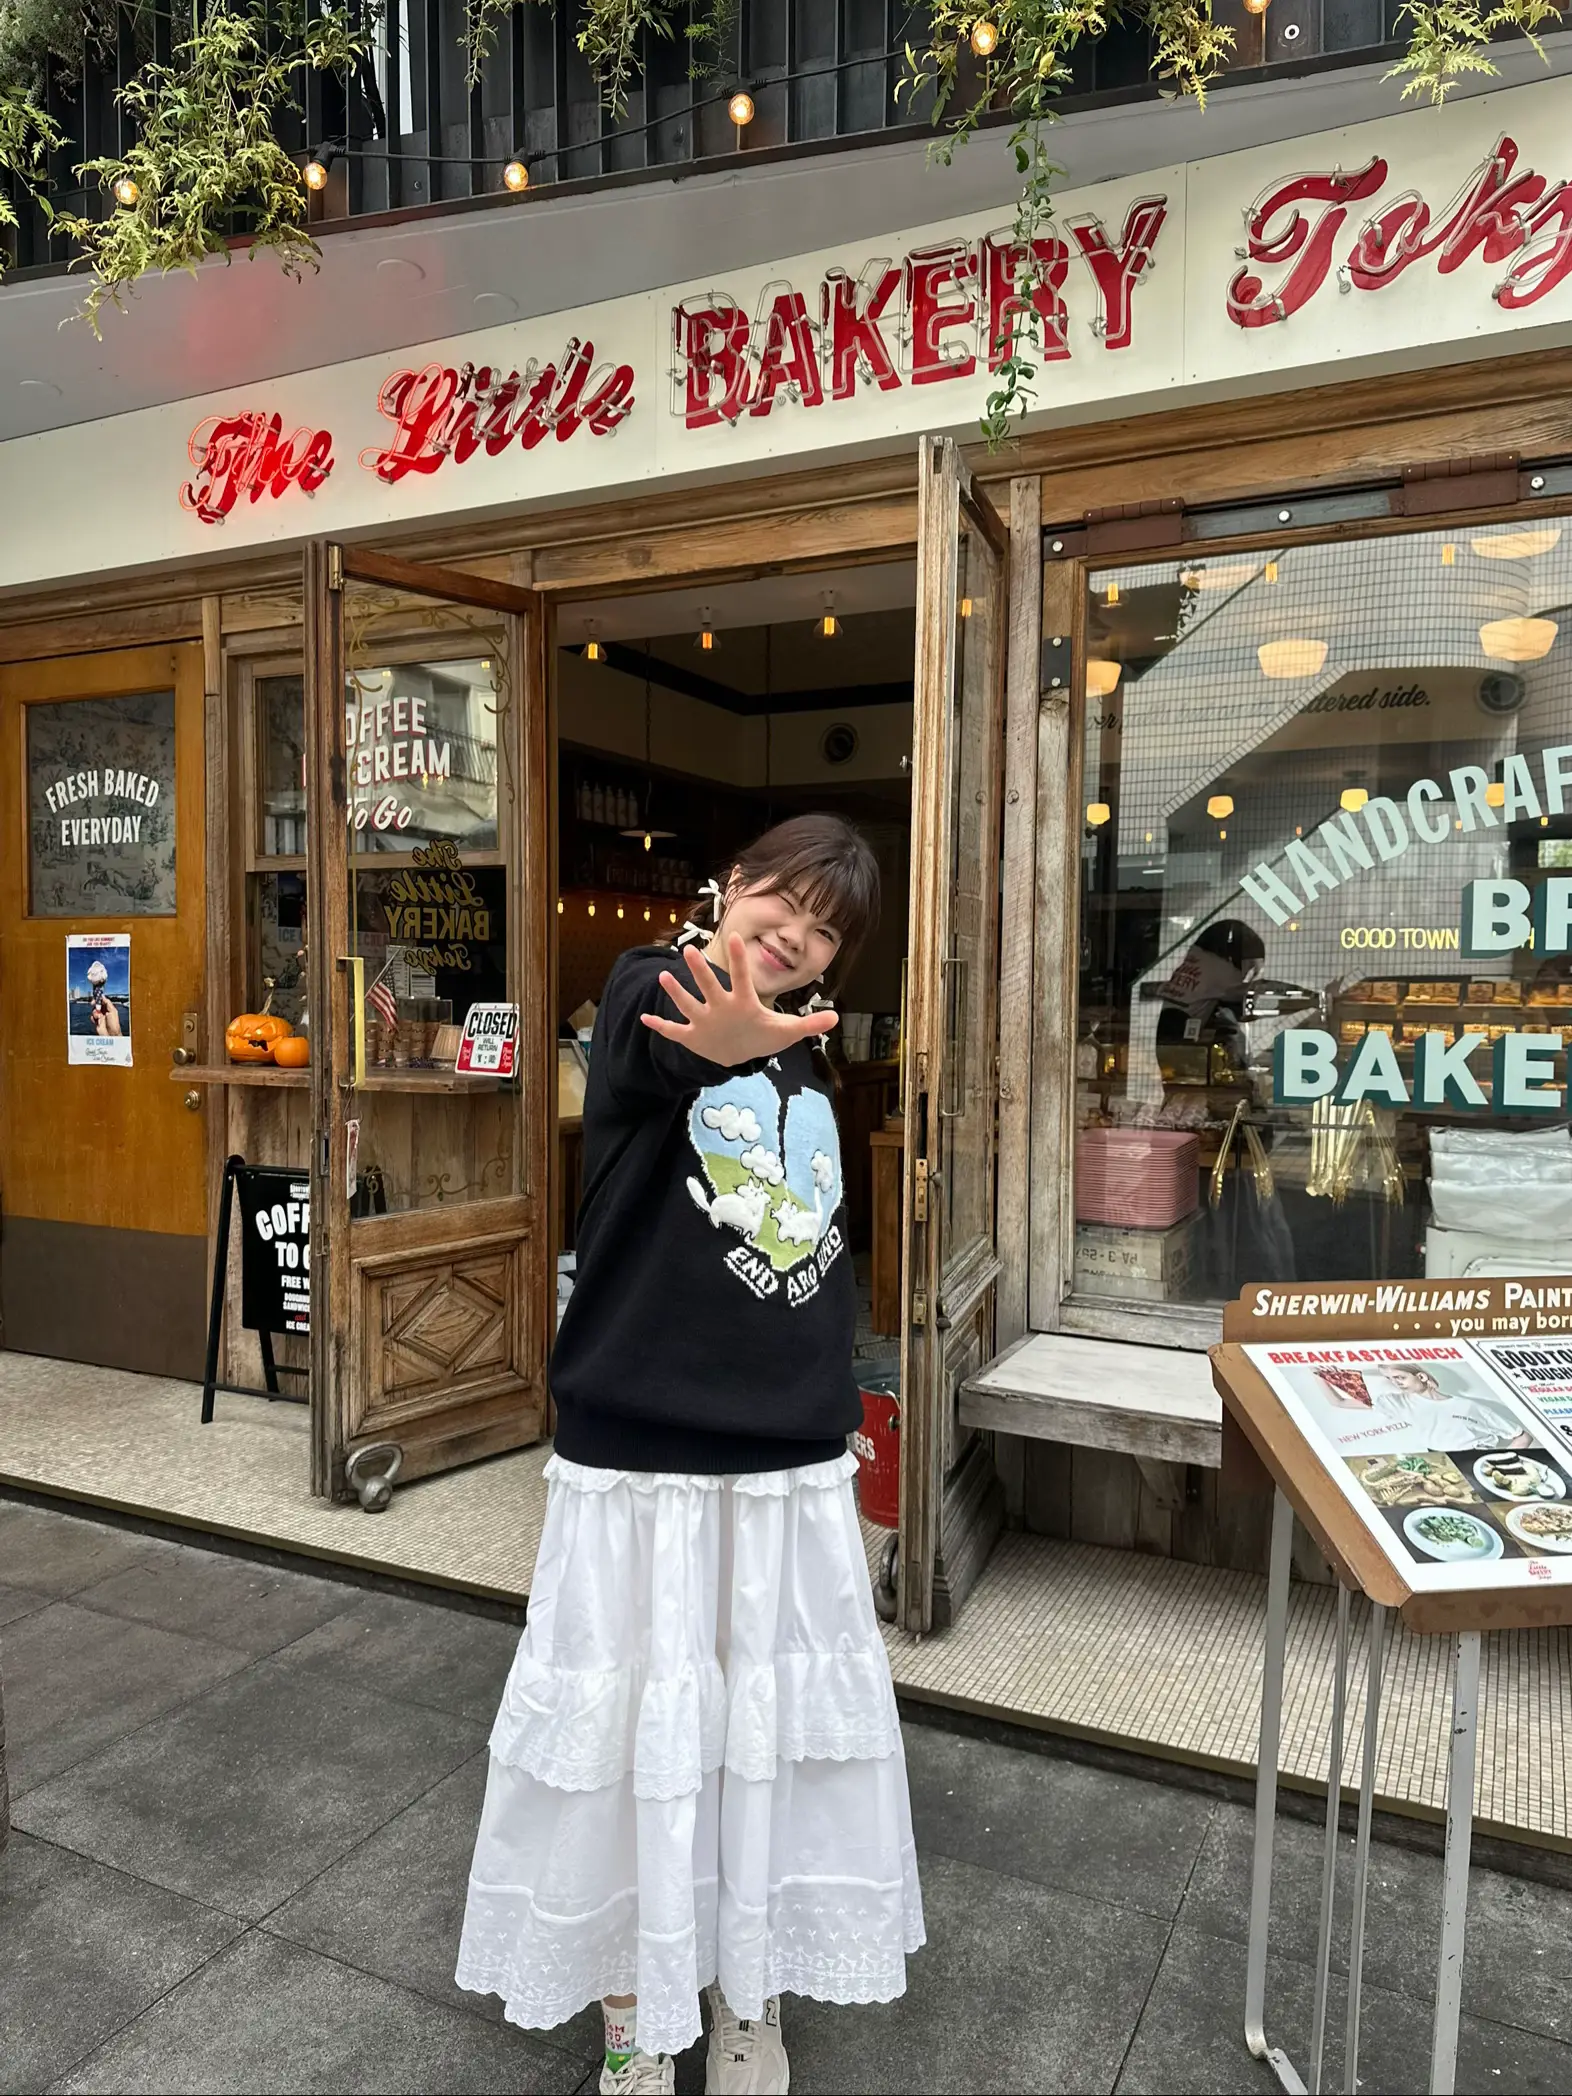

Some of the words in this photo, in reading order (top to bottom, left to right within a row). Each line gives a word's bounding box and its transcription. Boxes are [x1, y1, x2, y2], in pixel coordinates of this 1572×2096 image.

[180, 411, 336, 525] The
[358, 337, 636, 485] Little
[670, 193, 1168, 430] BAKERY
[1379, 684, 1432, 708] side.
[346, 696, 427, 747] OFFEE
[356, 739, 450, 786] CREAM
[45, 769, 99, 814] FRESH
[104, 768, 160, 808] BAKED
[371, 794, 413, 830] Go
[61, 815, 142, 846] EVERYDAY
[1340, 927, 1396, 950] GOOD
[1399, 927, 1460, 950] TOWN
[467, 1011, 518, 1039] CLOSED
[1277, 1028, 1565, 1111] BAKE
[275, 1241, 299, 1269] TO
[281, 1274, 302, 1289] FREE
[725, 1246, 780, 1298] END
[286, 1320, 296, 1330] ICE
[1450, 1317, 1485, 1337] you
[1492, 1316, 1531, 1335] may
[1267, 1347, 1464, 1365] BREAKFAST&LUNCH
[1337, 1433, 1361, 1445] NEW
[1362, 1425, 1388, 1439] YORK
[1385, 1420, 1413, 1433] PIZZA
